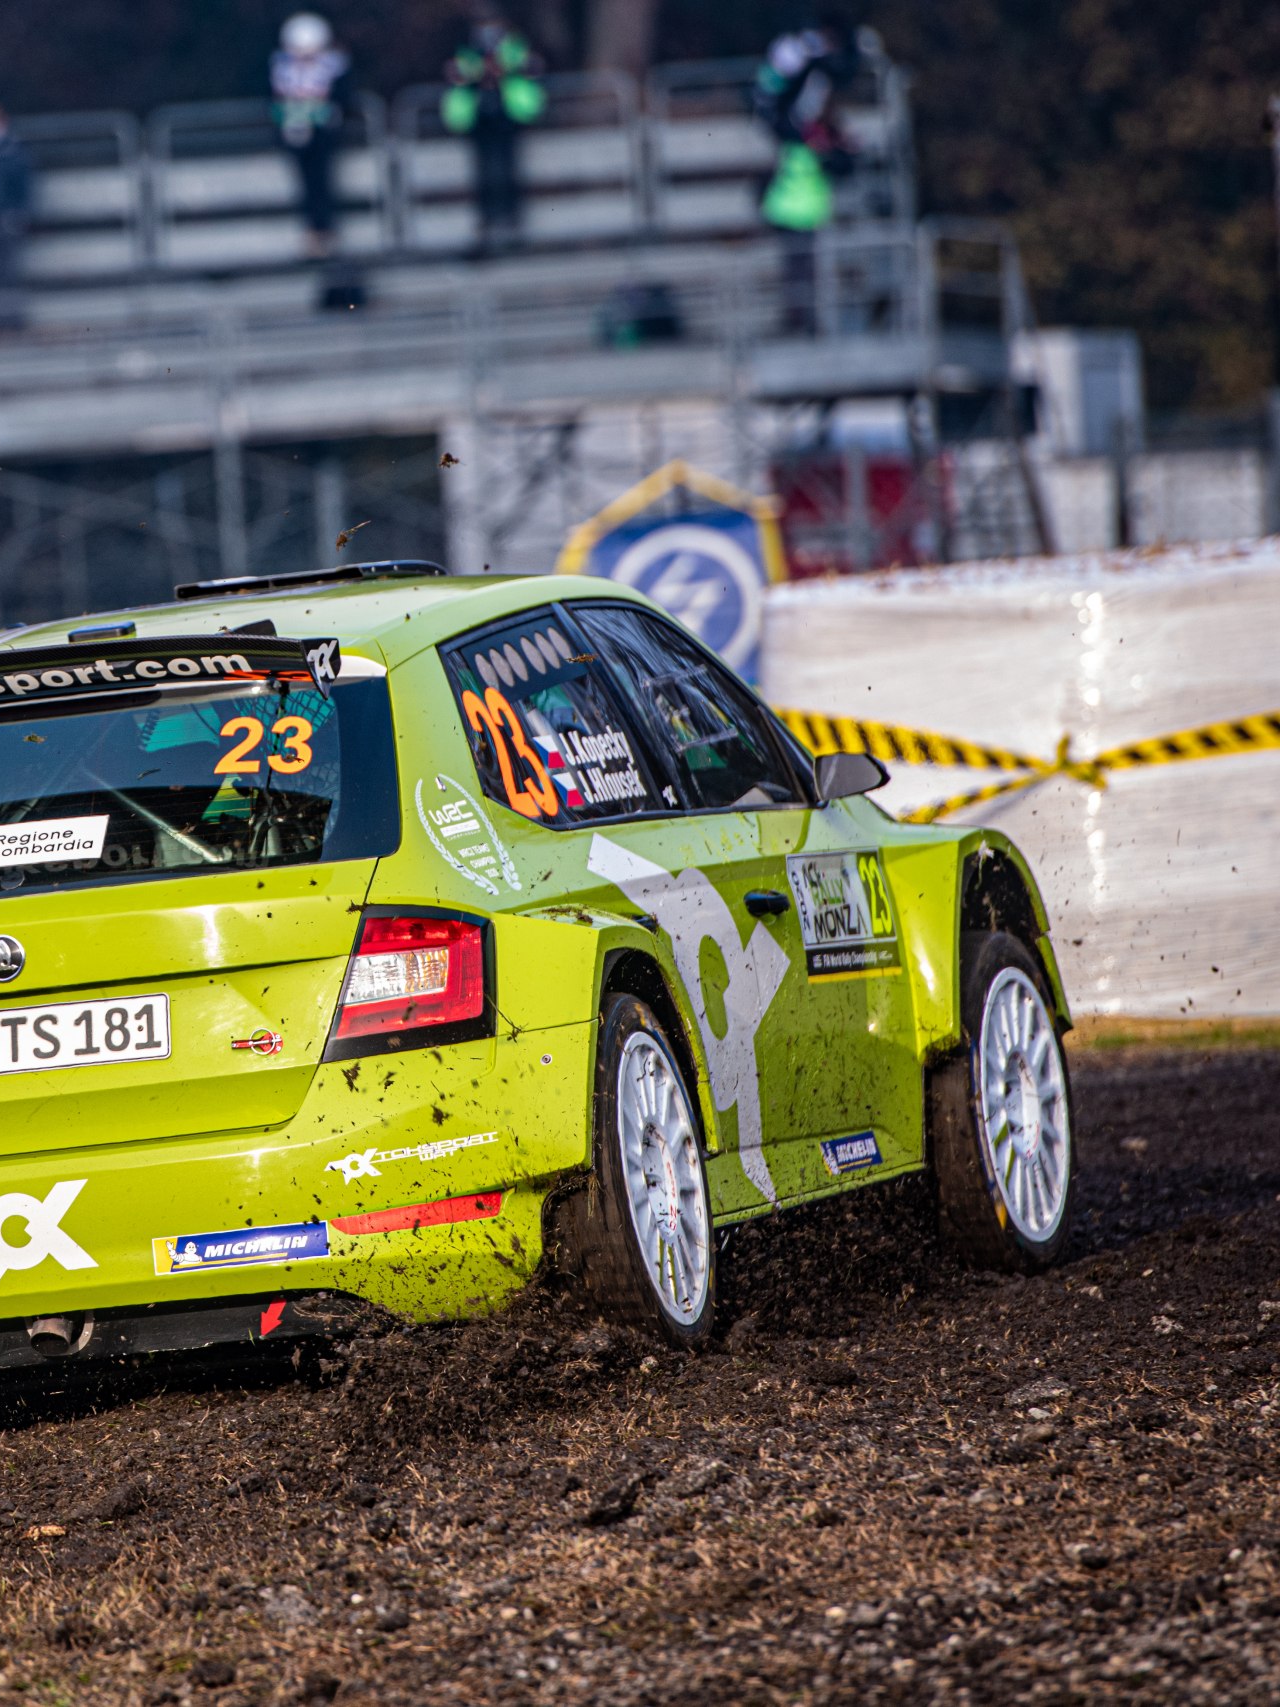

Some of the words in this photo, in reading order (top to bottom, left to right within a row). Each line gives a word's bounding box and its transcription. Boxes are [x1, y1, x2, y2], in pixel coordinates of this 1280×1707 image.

[214, 715, 314, 775] 23
[462, 686, 559, 817] 23
[558, 725, 635, 769] J.Kopecky
[577, 763, 647, 805] J.Hlousek
[858, 856, 893, 935] 23
[814, 904, 868, 943] MONZA
[0, 1013, 62, 1063] TS
[73, 1003, 162, 1056] 181
[204, 1235, 309, 1259] MICHELIN
